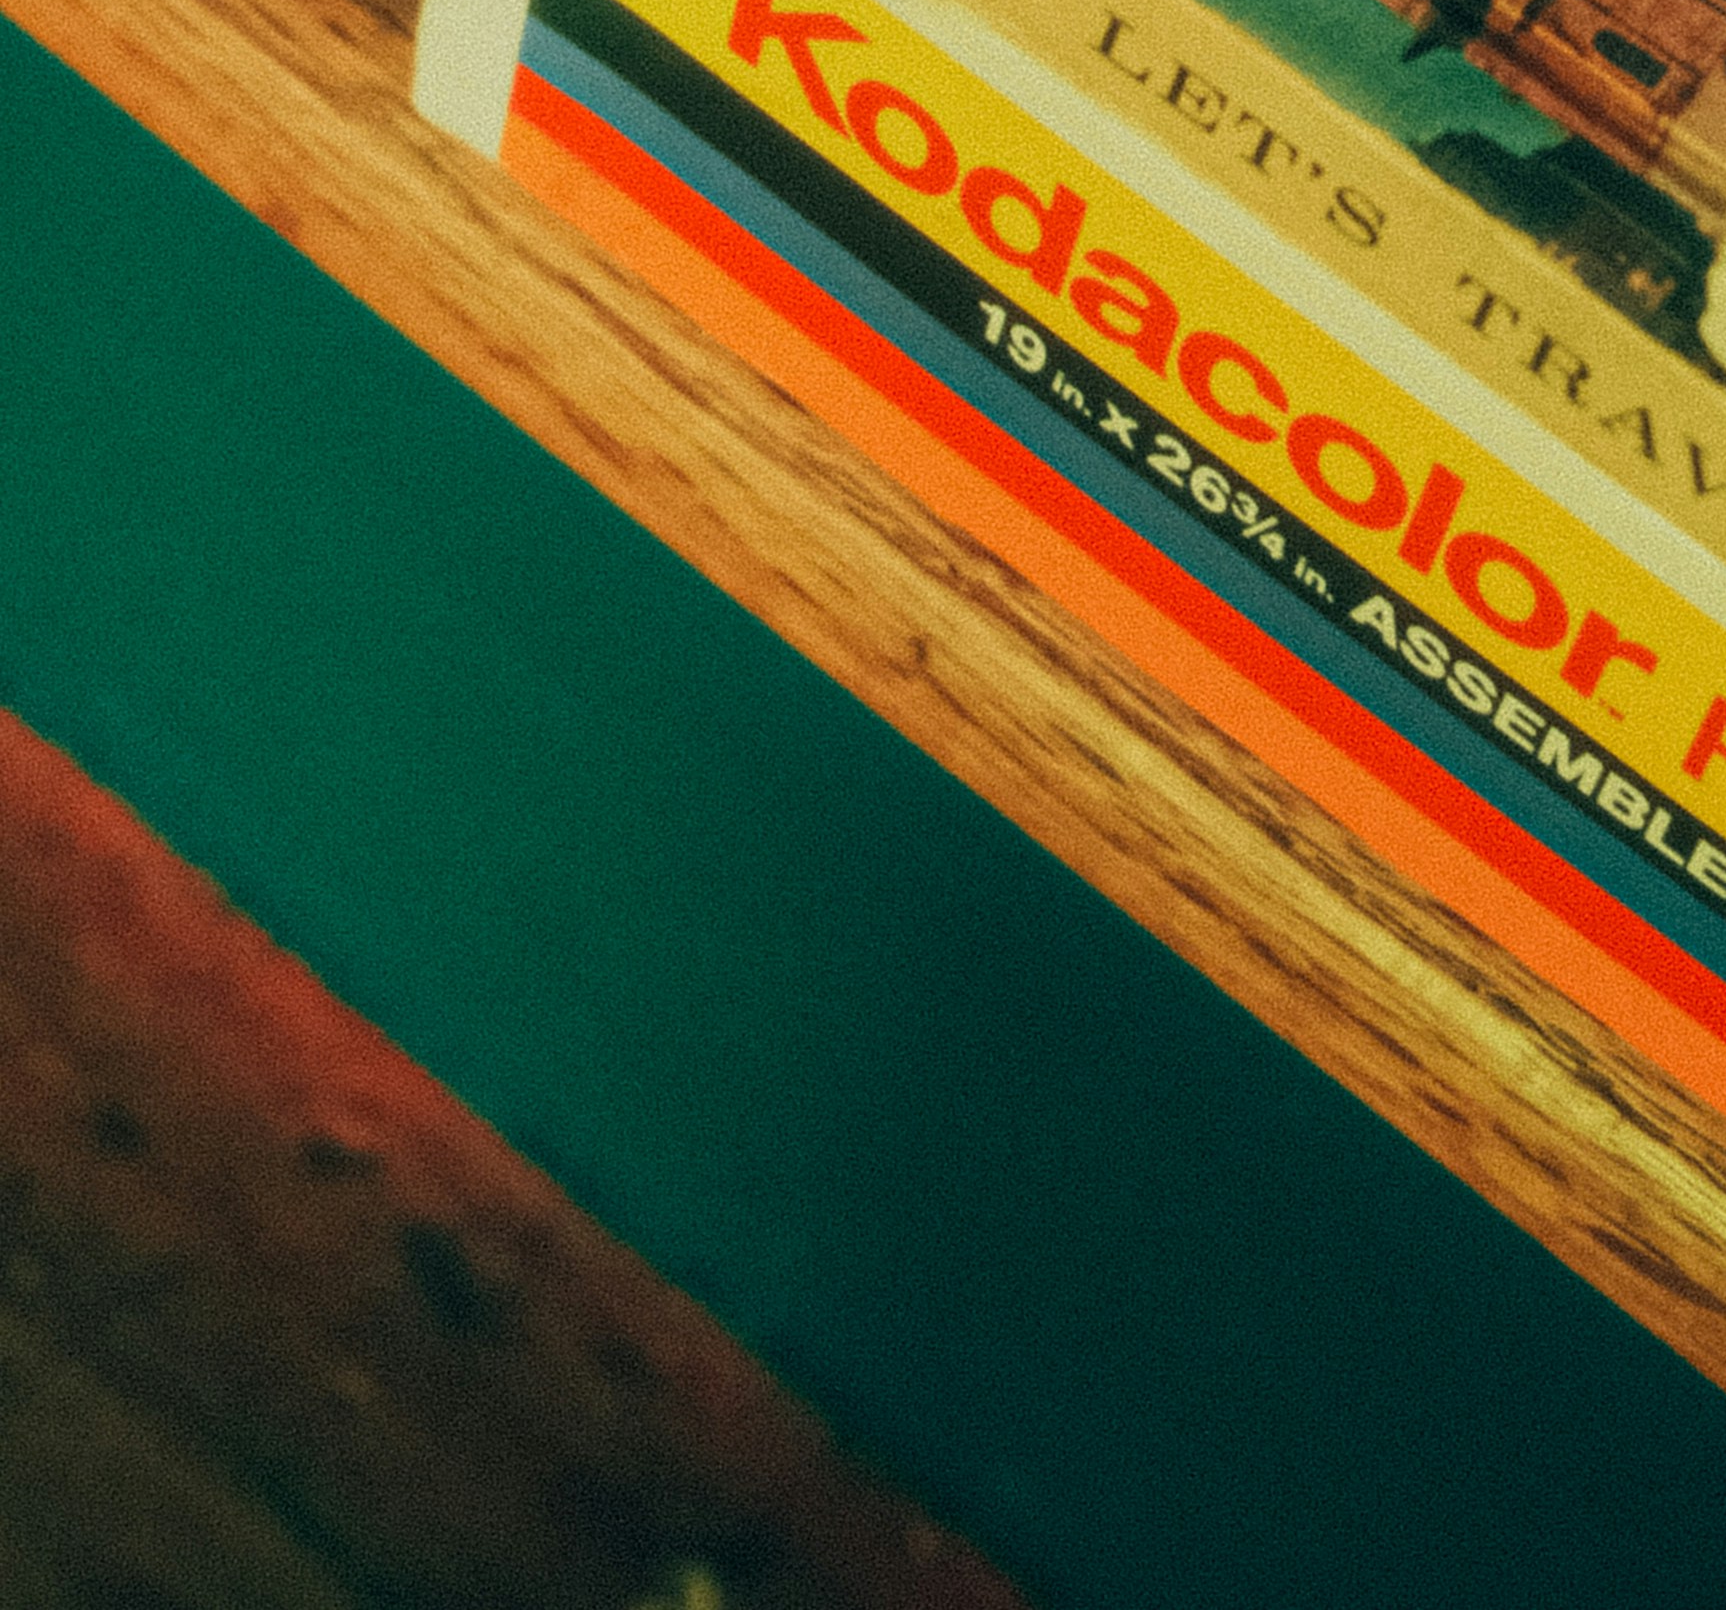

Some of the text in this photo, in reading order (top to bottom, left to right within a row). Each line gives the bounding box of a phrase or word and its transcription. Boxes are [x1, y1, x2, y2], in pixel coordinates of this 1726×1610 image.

[1090, 10, 1385, 249] LET'S
[977, 299, 1047, 374] 19
[1052, 371, 1093, 418] in.
[1294, 556, 1335, 604] in.
